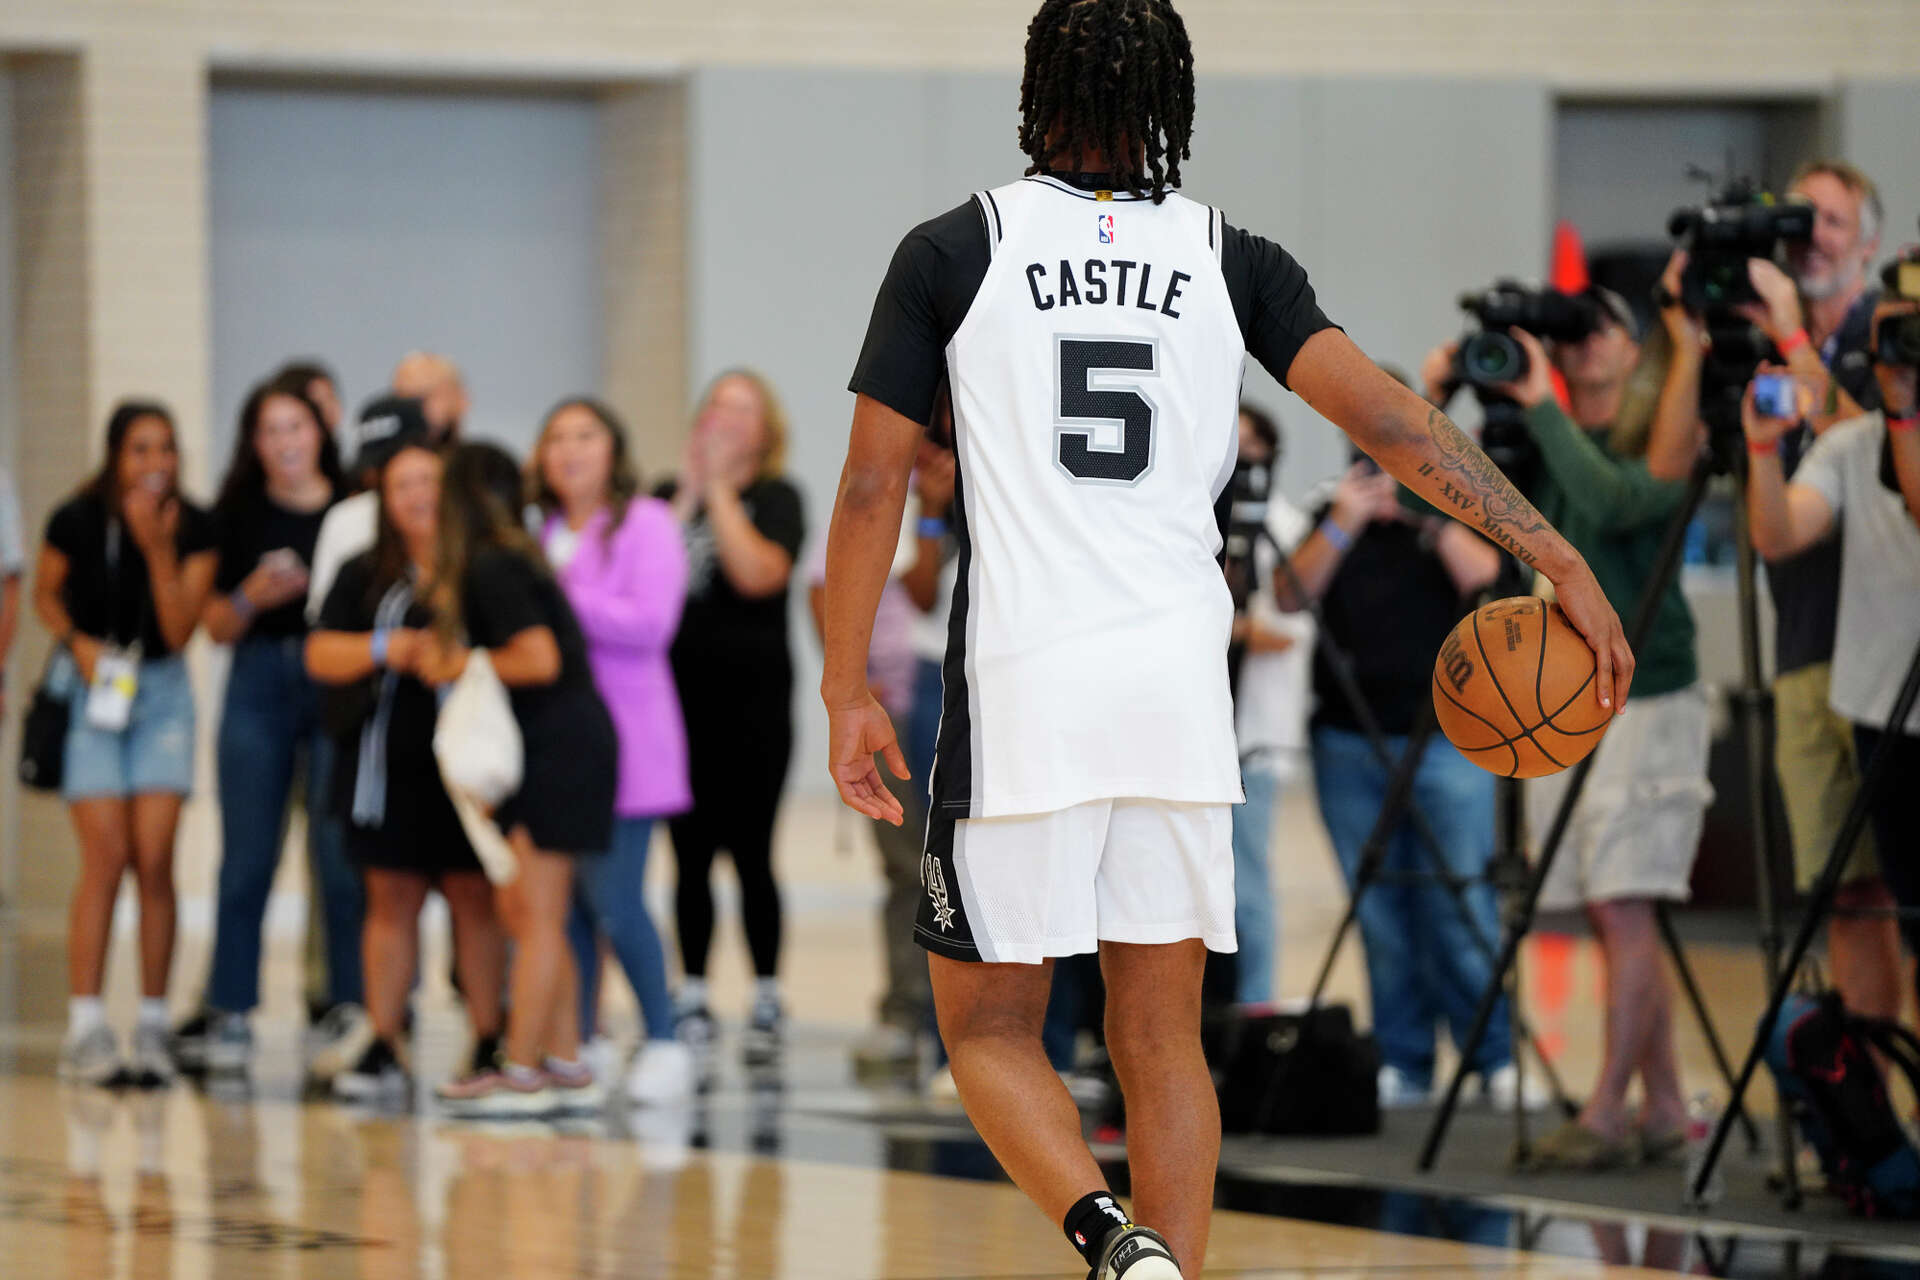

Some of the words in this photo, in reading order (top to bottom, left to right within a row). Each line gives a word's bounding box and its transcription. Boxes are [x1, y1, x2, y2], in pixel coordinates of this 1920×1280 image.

[1026, 259, 1191, 319] CASTLE
[1053, 333, 1160, 487] 5
[1418, 463, 1434, 476] II
[1439, 482, 1475, 509] XXV
[1481, 518, 1536, 563] MMXXII
